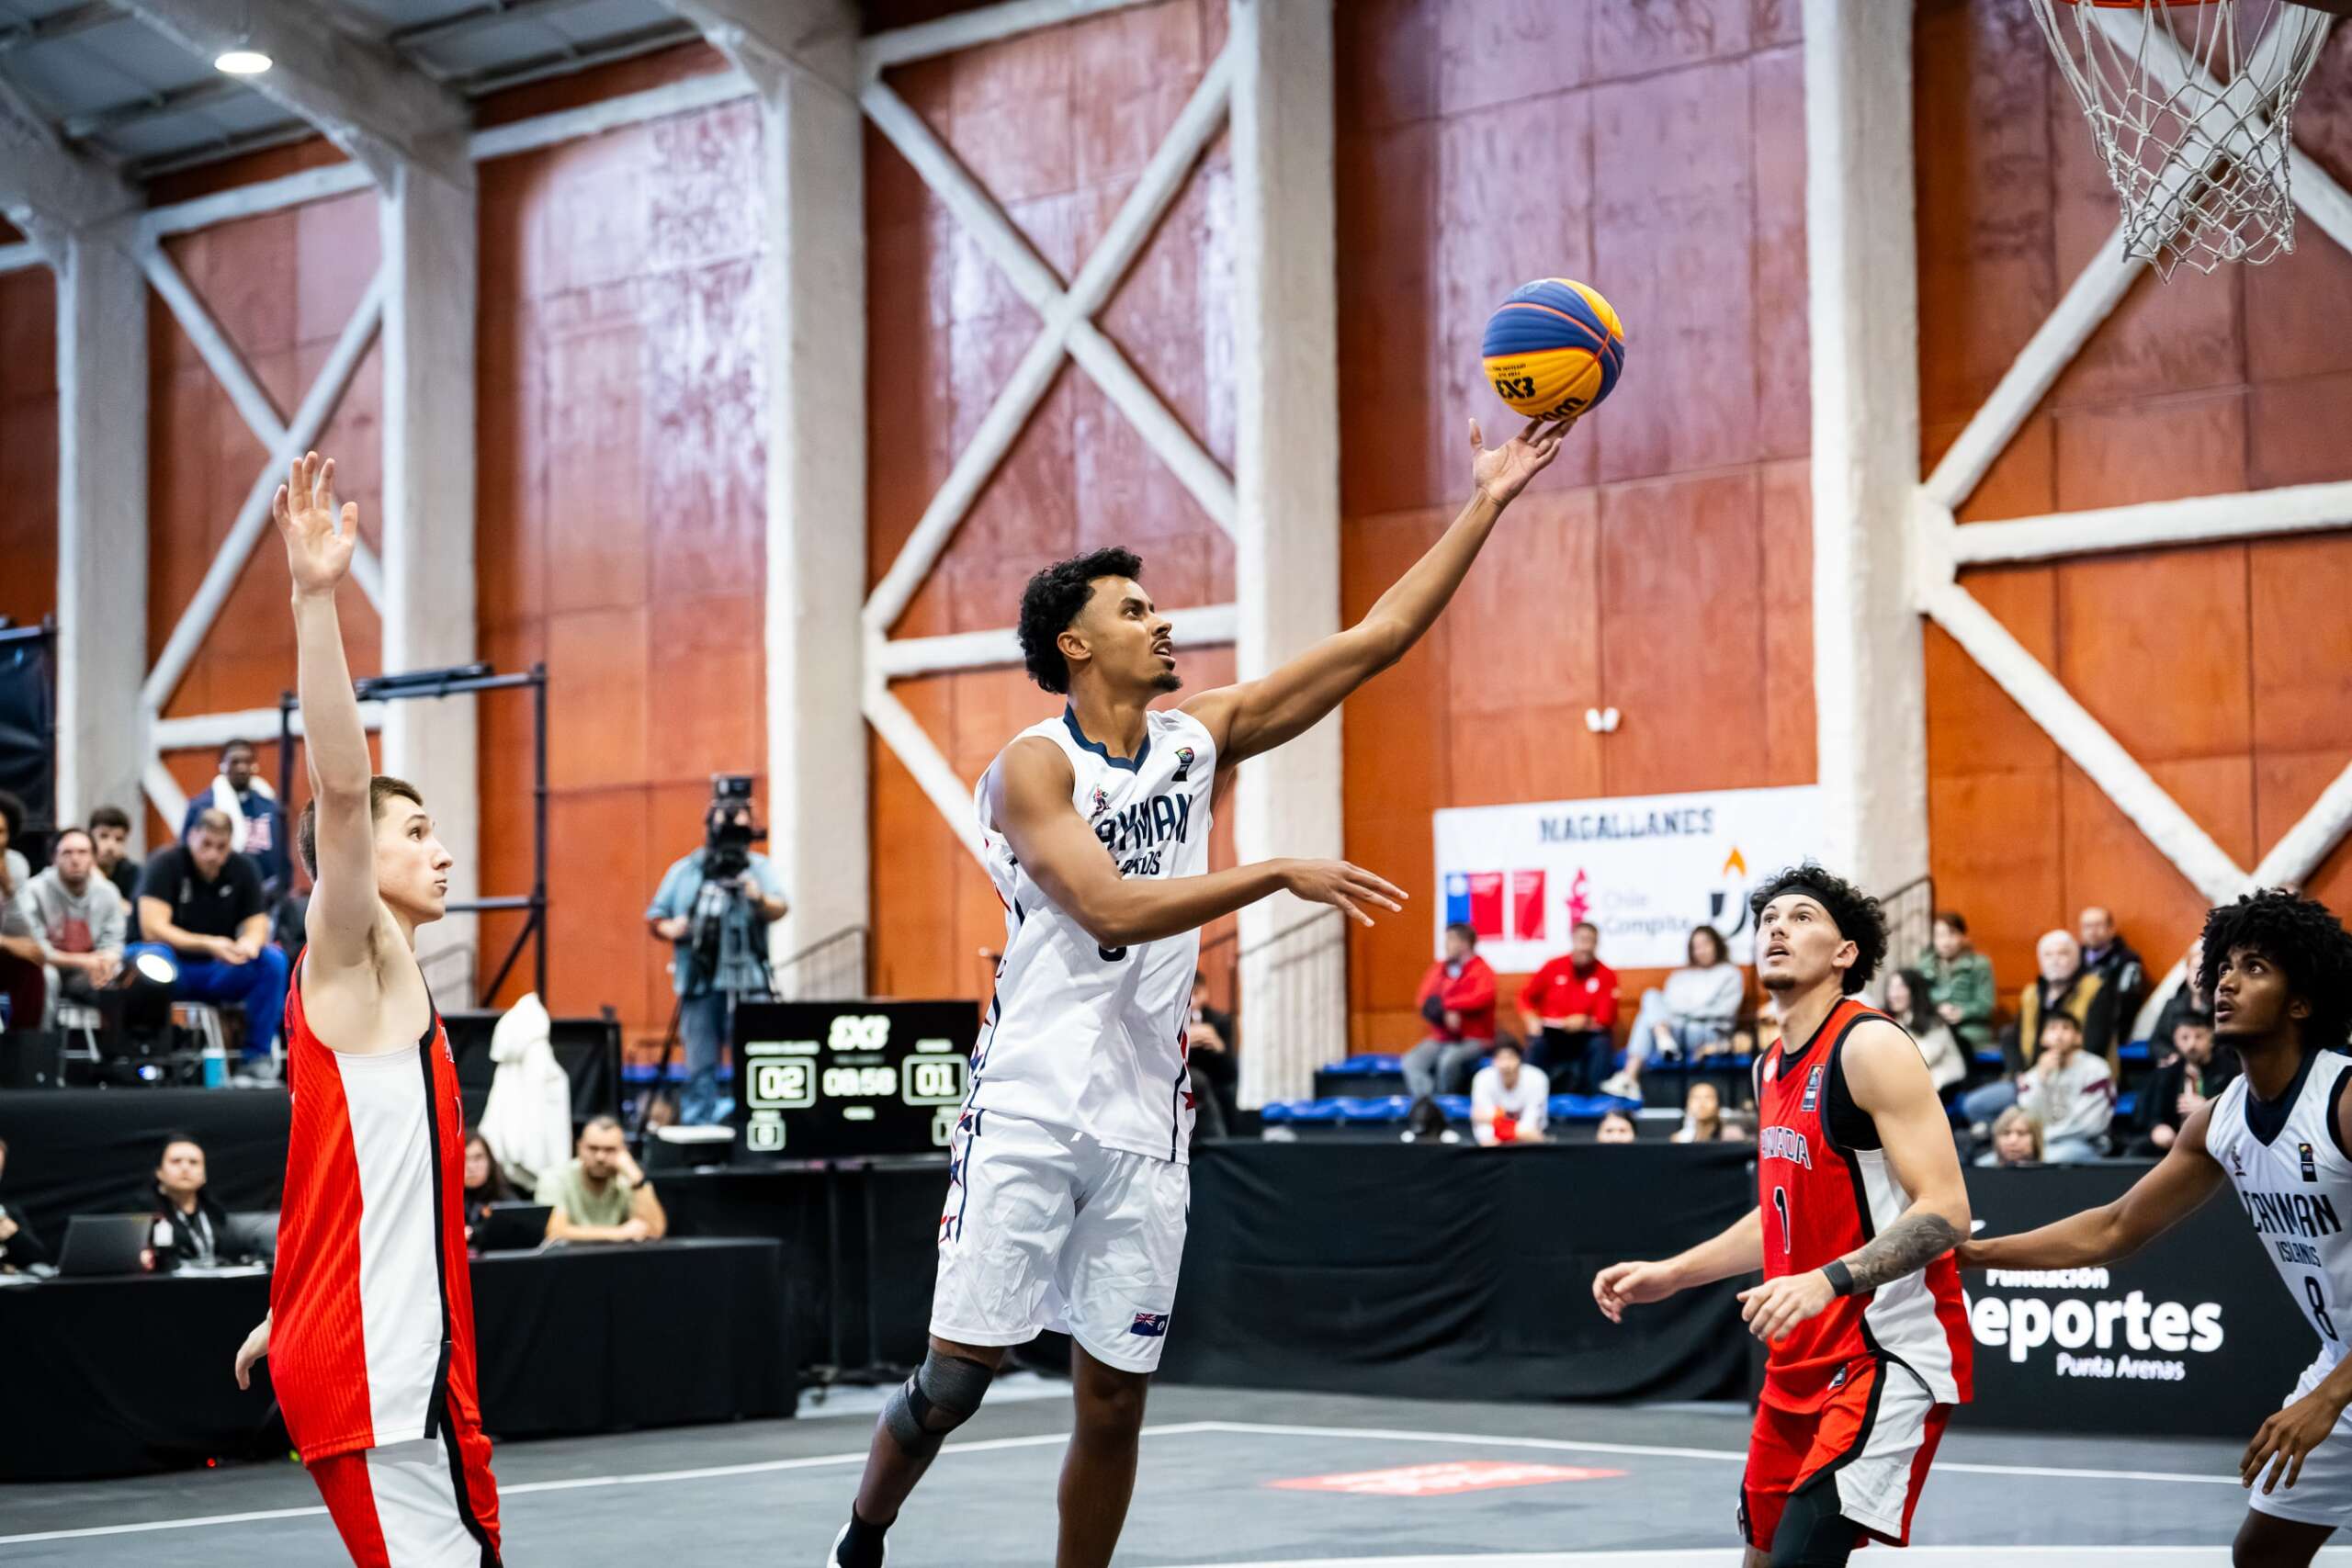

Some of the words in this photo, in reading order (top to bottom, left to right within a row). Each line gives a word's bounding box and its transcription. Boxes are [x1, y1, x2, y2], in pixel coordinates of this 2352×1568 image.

[1093, 793, 1193, 852] AYMAN
[759, 1066, 805, 1100] 02
[916, 1064, 956, 1097] 01
[1760, 1126, 1813, 1170] ANADA
[1774, 1186, 1791, 1255] 1
[2242, 1190, 2343, 1238] CAYMAN
[2275, 1241, 2322, 1268] ISLANDS
[1962, 1289, 2224, 1363] eportes
[2304, 1275, 2339, 1341] 8
[2055, 1352, 2114, 1379] Punta
[2116, 1354, 2186, 1381] Arenas
